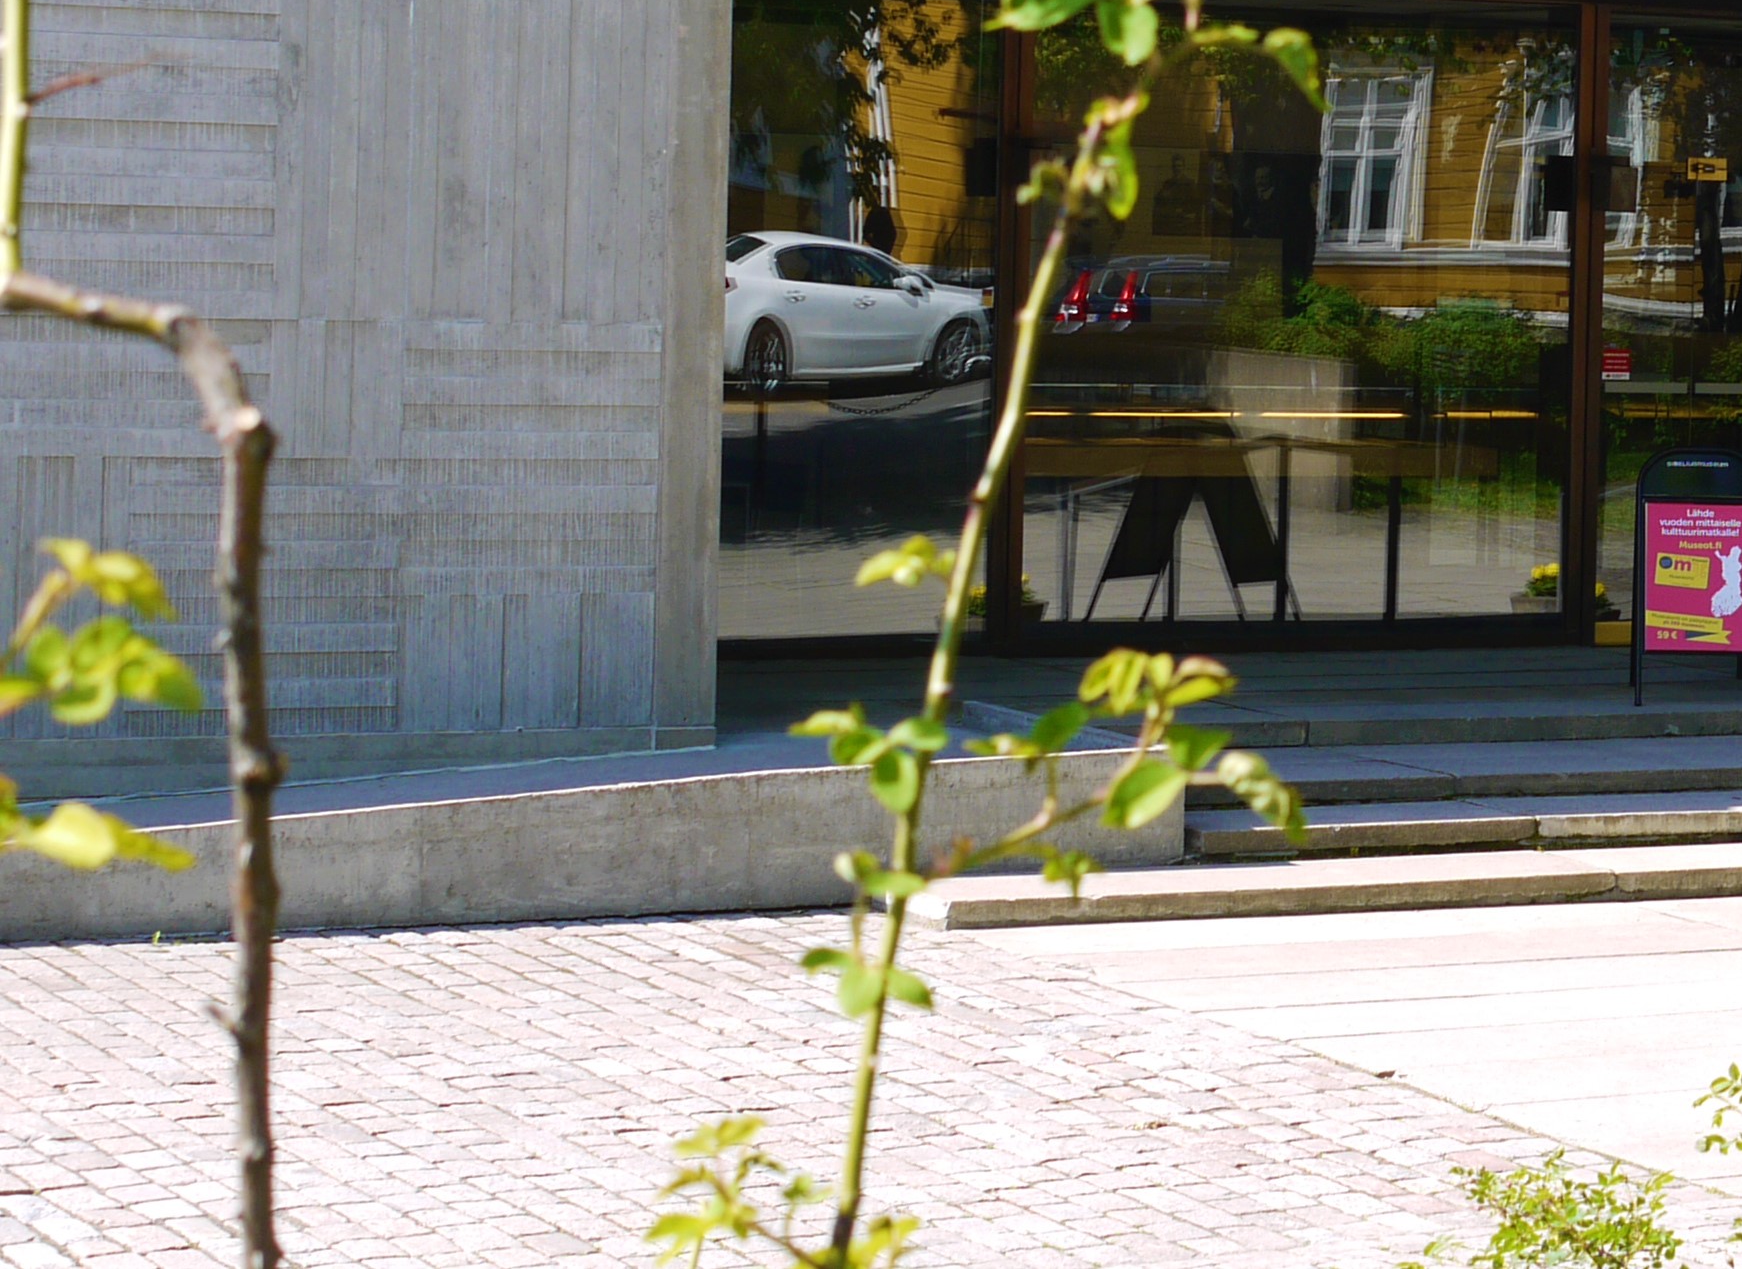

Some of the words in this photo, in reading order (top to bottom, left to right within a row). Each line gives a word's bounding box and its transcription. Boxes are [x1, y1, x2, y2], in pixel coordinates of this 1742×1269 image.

[1686, 508, 1715, 518] Lähde
[1659, 517, 1694, 527] vuoden
[1695, 518, 1742, 528] mittaiselle
[1679, 540, 1722, 550] Museot.fi
